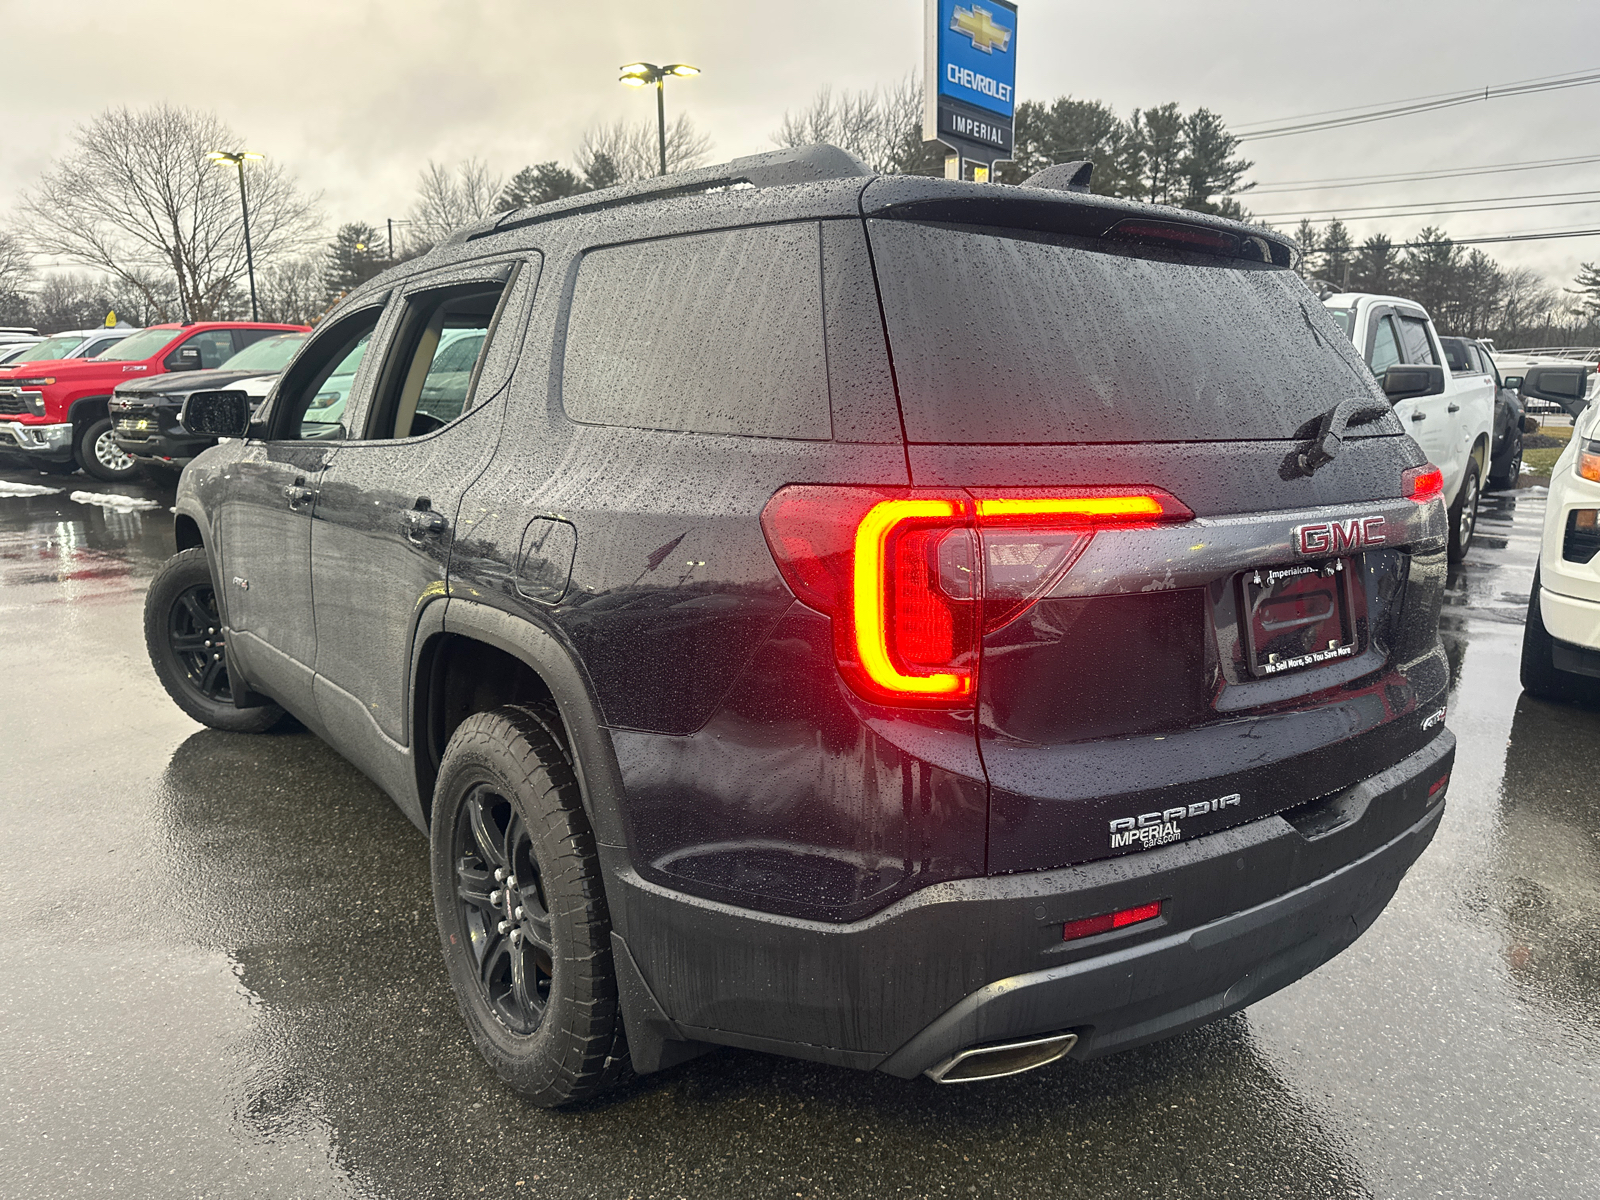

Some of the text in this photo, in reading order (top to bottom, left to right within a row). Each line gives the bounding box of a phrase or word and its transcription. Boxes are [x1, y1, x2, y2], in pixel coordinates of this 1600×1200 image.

[947, 63, 1012, 103] CHEVROLET
[952, 114, 1003, 145] IMPERIAL
[1300, 516, 1386, 554] GMC
[1265, 647, 1351, 674] We Sell More, So You Save More
[1109, 793, 1241, 833] ACADIA
[1110, 821, 1181, 849] IMPERIAL
[1143, 832, 1181, 848] cars.com
